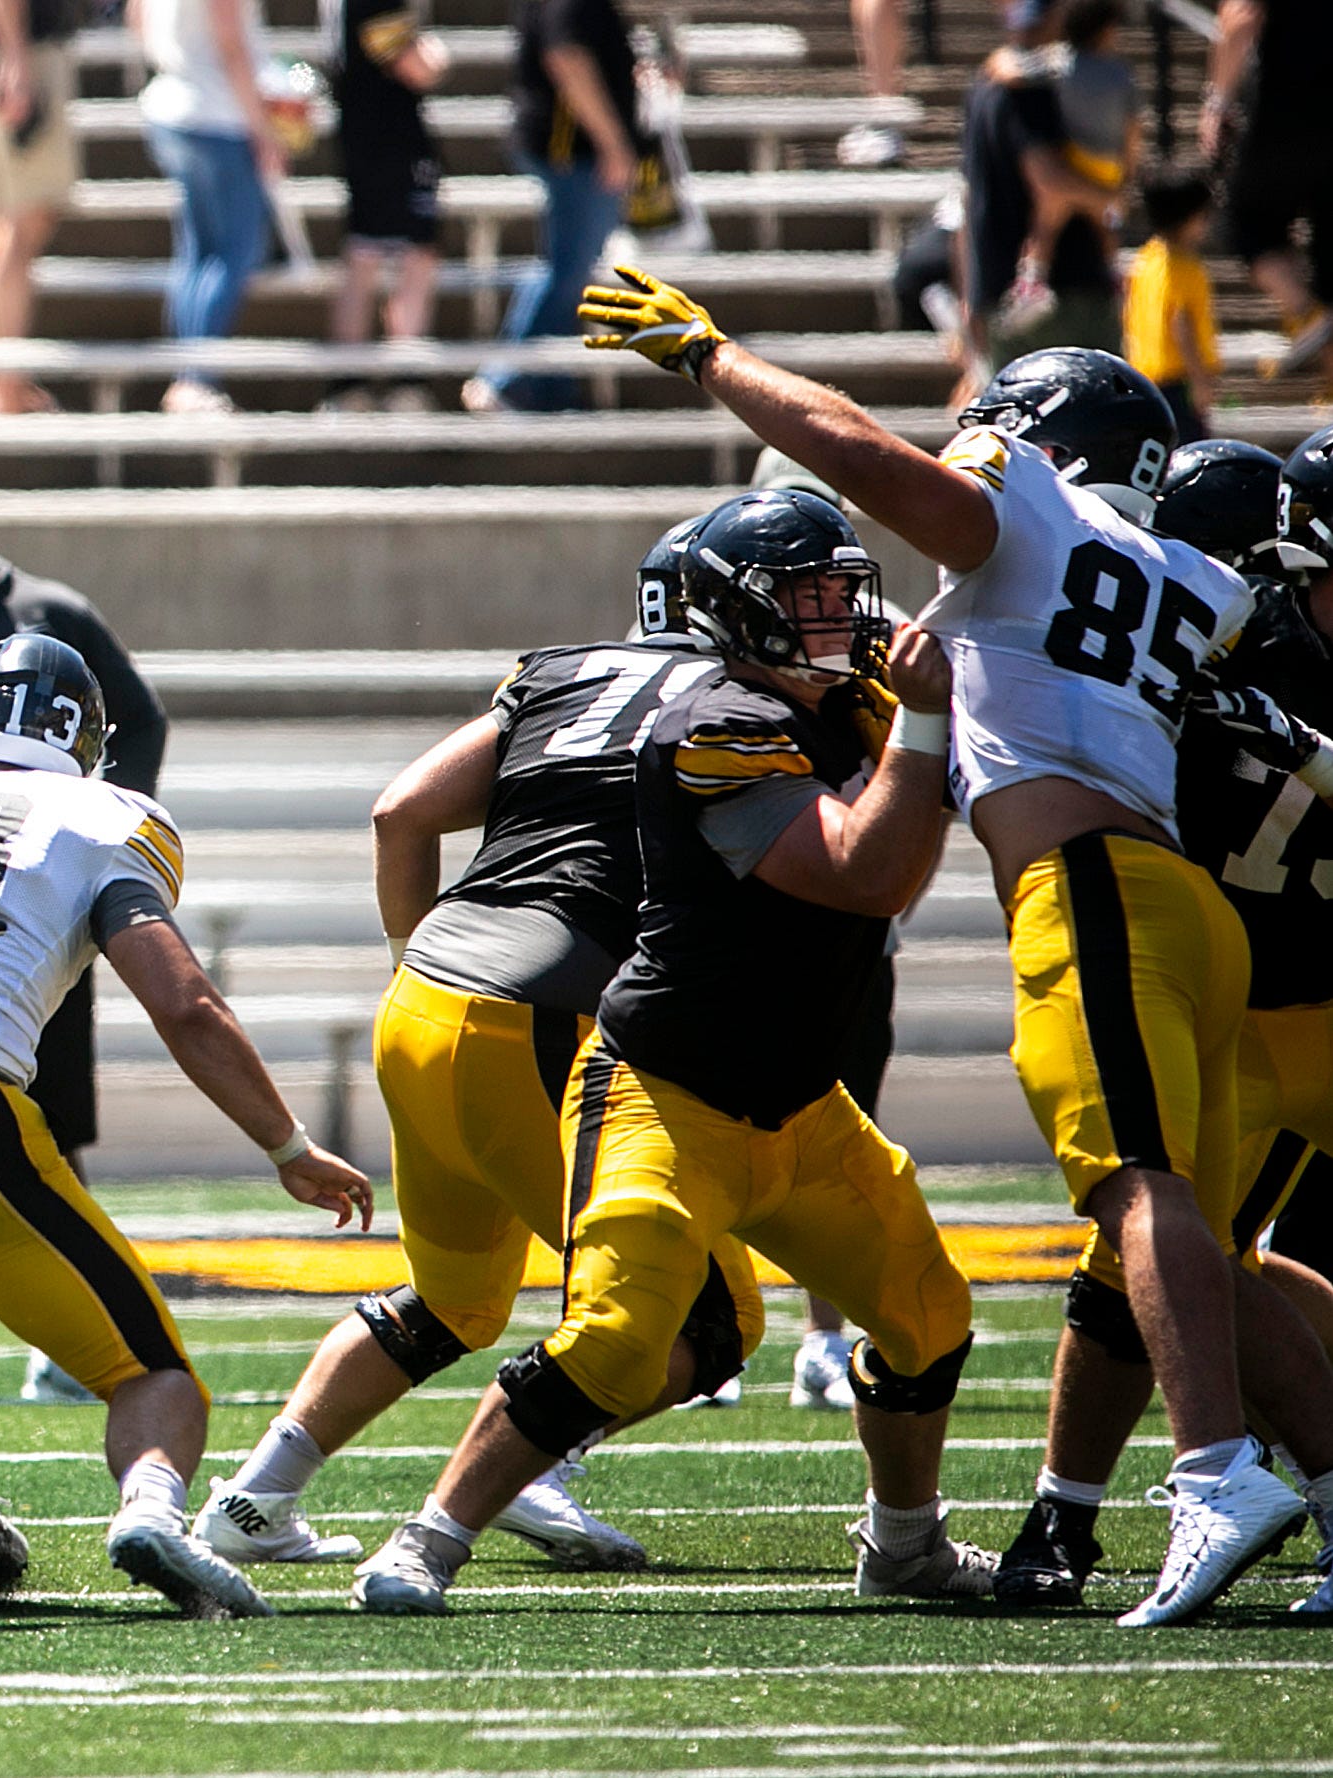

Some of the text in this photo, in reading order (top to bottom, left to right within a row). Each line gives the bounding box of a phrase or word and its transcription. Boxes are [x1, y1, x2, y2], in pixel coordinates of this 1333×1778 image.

[1130, 438, 1166, 493] 8
[1043, 539, 1218, 728] 85
[5, 683, 83, 751] 13
[219, 1494, 269, 1536] NIKE
